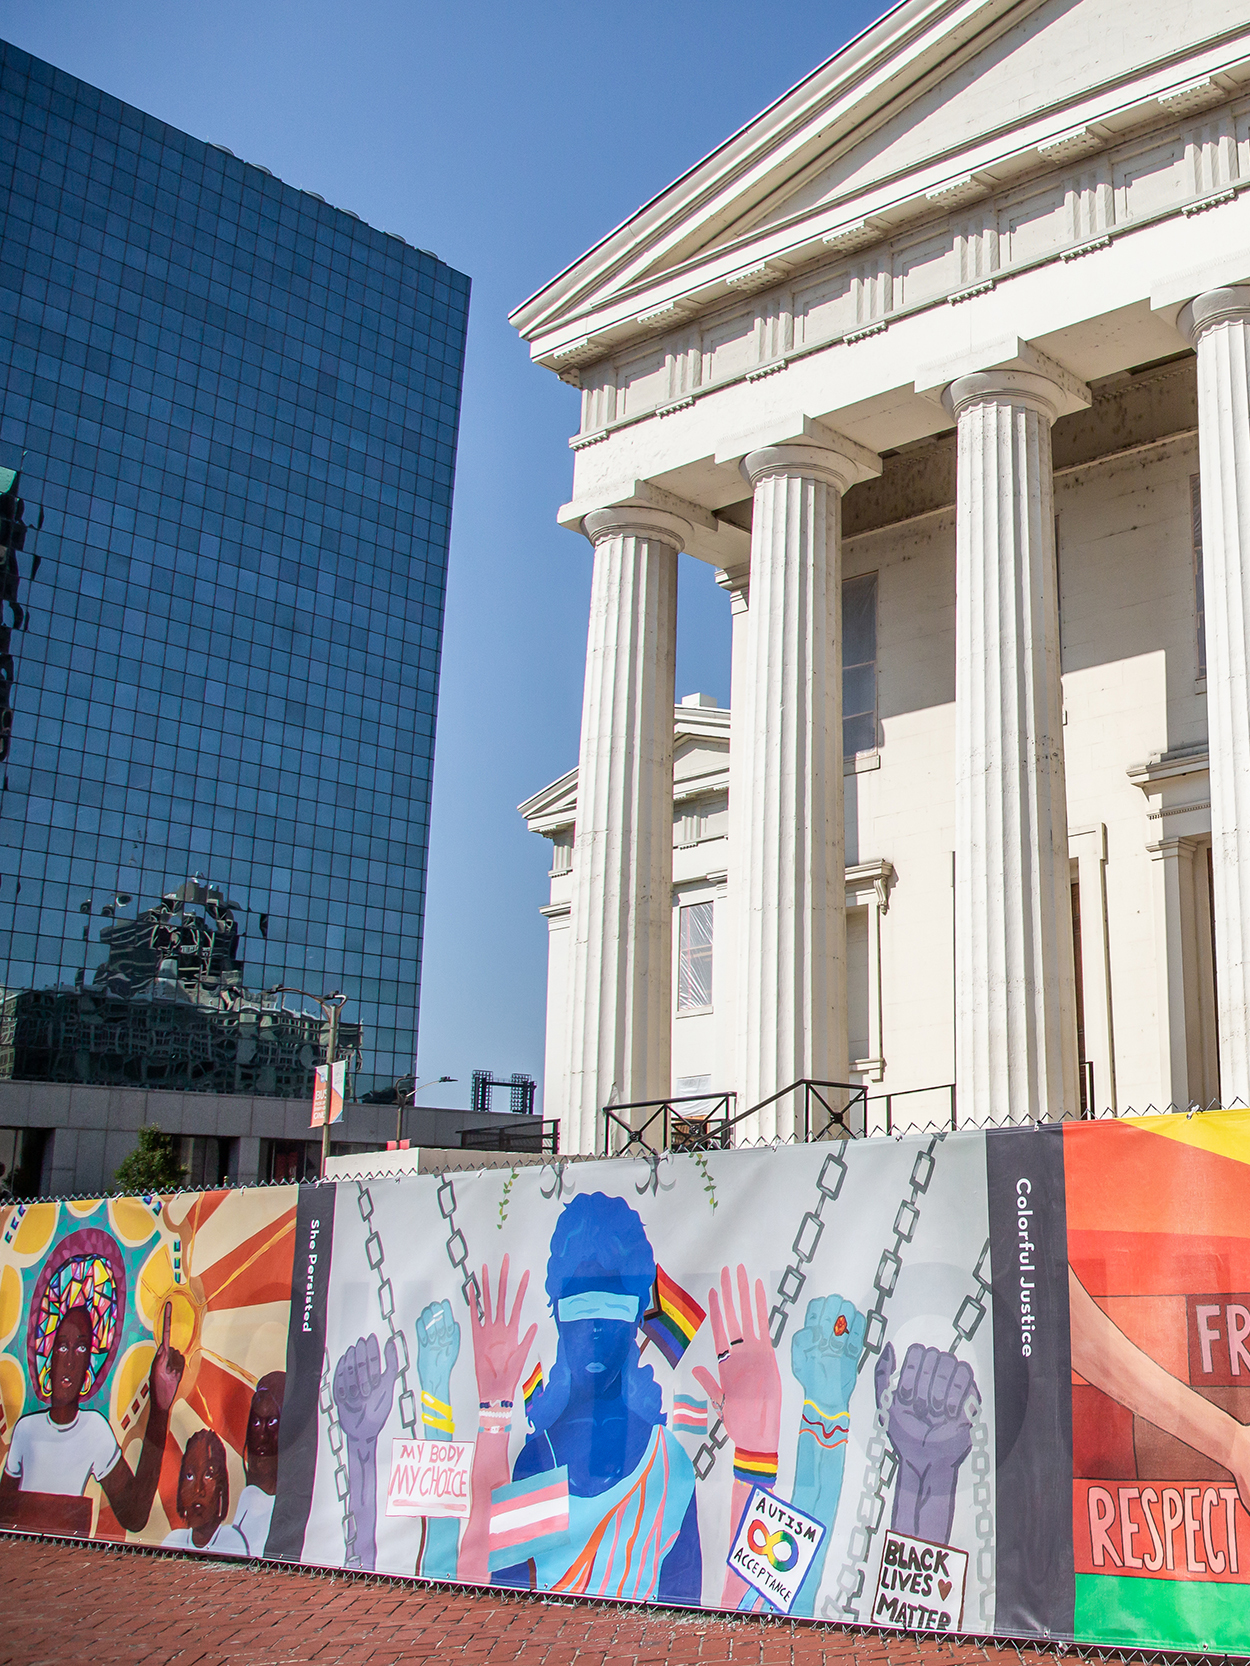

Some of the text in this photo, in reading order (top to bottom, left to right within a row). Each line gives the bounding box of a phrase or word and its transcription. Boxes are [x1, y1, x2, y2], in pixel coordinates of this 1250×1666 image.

[302, 1219, 320, 1332] She Persisted
[1016, 1178, 1036, 1357] Colorful Justice
[400, 1442, 465, 1467] MY BODY
[388, 1464, 468, 1498] MY CHOICE
[756, 1497, 817, 1543] AUTISM
[1087, 1484, 1240, 1574] RESPECT
[733, 1547, 793, 1603] ACCEPTANCE
[884, 1539, 950, 1577] BLACK
[880, 1566, 933, 1597] LIVES
[876, 1593, 952, 1631] MATTER
